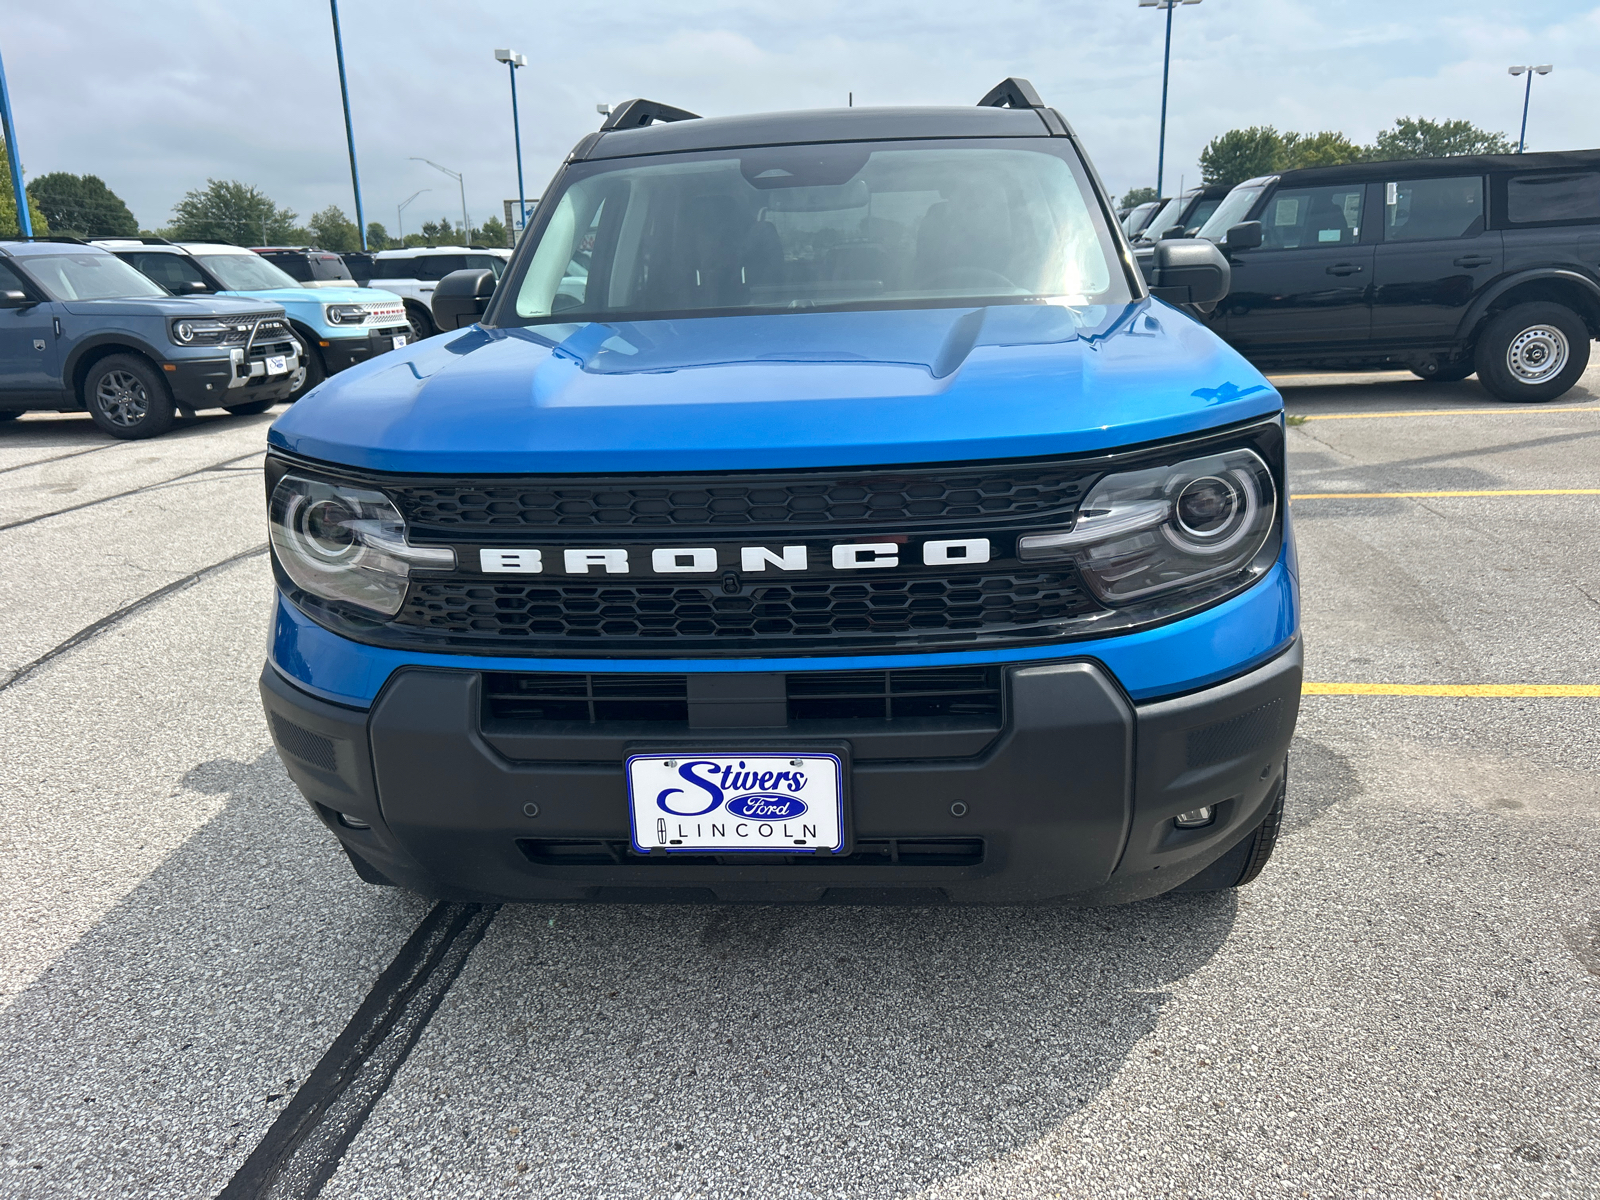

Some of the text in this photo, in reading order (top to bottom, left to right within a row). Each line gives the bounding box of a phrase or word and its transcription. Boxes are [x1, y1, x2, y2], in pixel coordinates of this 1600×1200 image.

[479, 538, 991, 574] BRONCO
[656, 760, 808, 817] Stivers
[743, 796, 791, 816] Ford
[678, 823, 817, 838] LINCOLN
